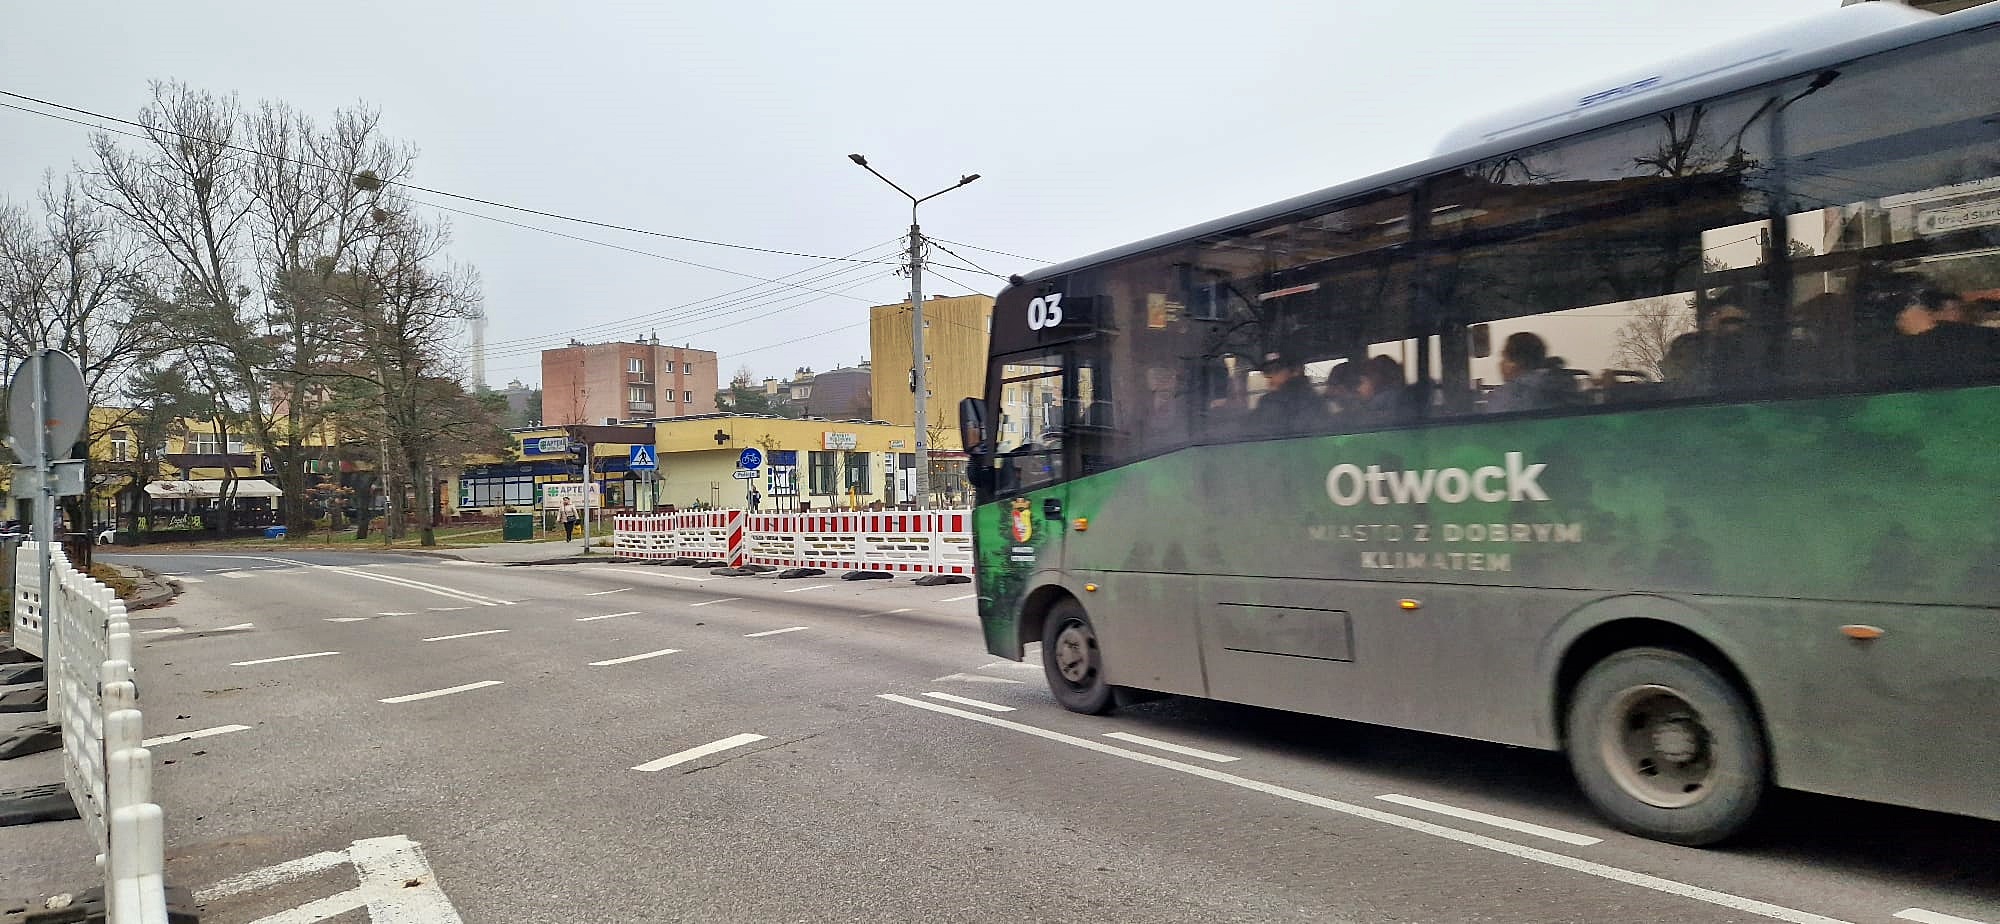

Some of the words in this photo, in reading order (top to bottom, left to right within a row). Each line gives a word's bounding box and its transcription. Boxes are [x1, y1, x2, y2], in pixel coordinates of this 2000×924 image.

[1027, 292, 1063, 331] 03
[1325, 451, 1550, 506] Otwock
[1307, 524, 1403, 542] MIASTO
[1412, 524, 1432, 542] Z
[1443, 523, 1584, 543] DOBRYM
[1360, 551, 1512, 572] KLIMATEM
